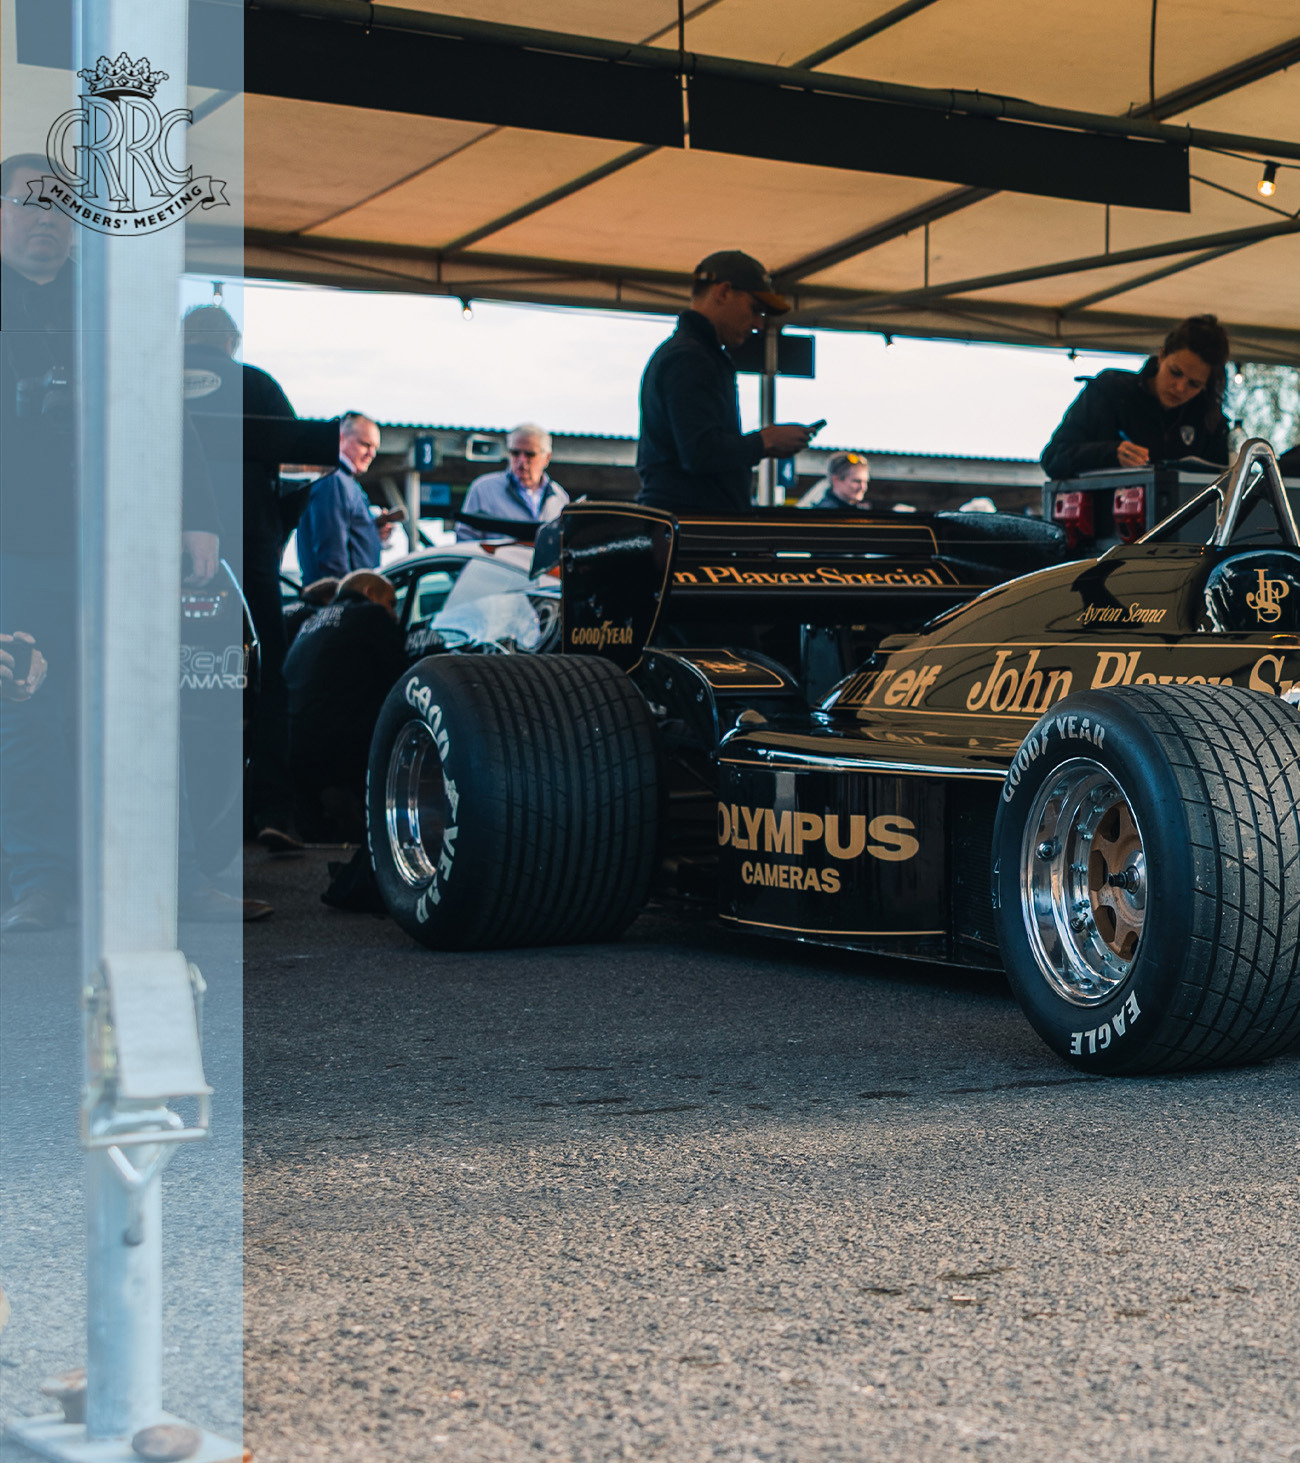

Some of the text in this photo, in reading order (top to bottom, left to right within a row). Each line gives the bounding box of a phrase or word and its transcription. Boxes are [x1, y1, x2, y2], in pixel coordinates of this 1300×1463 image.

[1076, 601, 1168, 625] Ayrton Senna
[571, 622, 633, 649] GOODYEAR
[180, 674, 248, 689] AMARO
[884, 664, 943, 707] elf
[966, 650, 1074, 713] John
[717, 801, 920, 862] OLYMPUS
[741, 860, 841, 894] CAMERAS
[1069, 989, 1142, 1056] EAGLE
